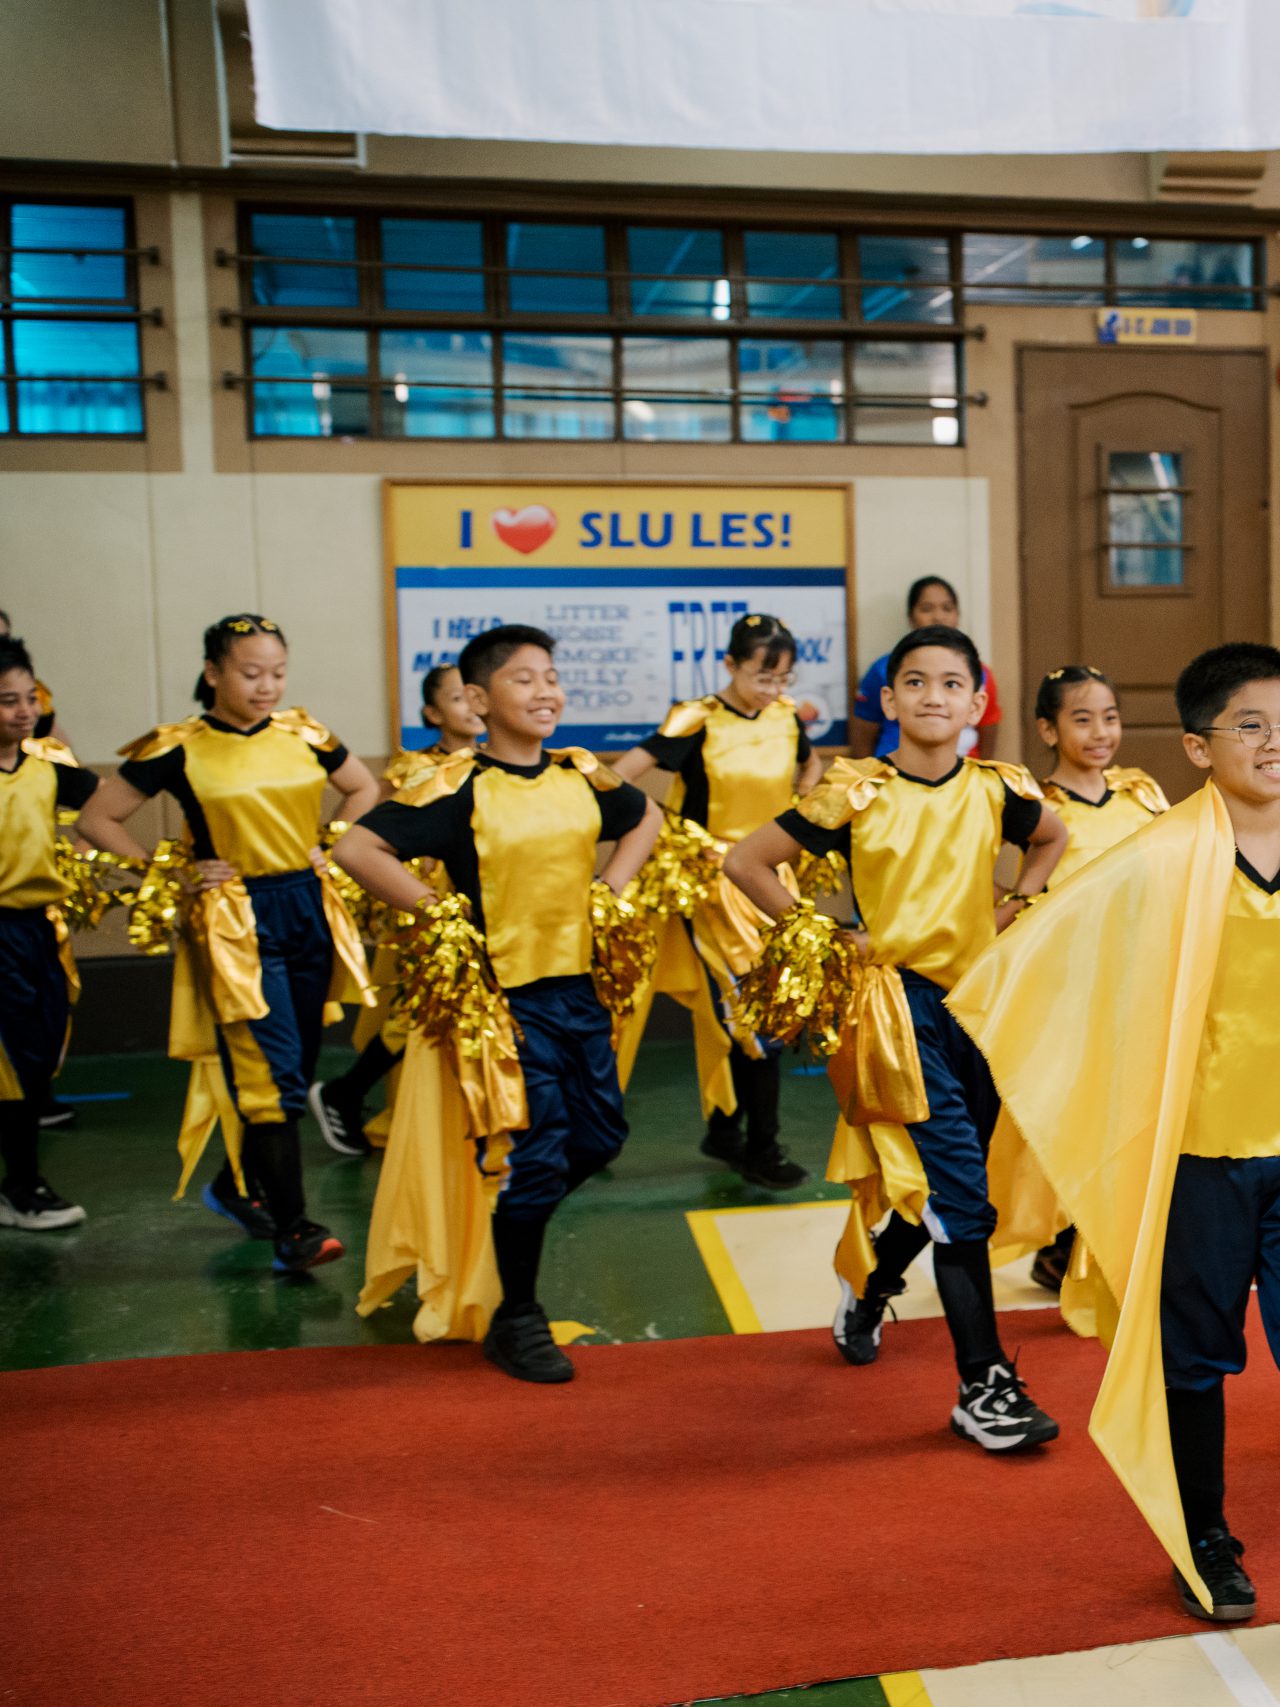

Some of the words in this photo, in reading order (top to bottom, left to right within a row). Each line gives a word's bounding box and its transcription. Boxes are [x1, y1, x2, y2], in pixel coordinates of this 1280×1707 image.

[460, 510, 472, 548] I
[579, 512, 673, 548] SLU
[690, 512, 791, 548] LES!
[546, 603, 630, 620] LITTER
